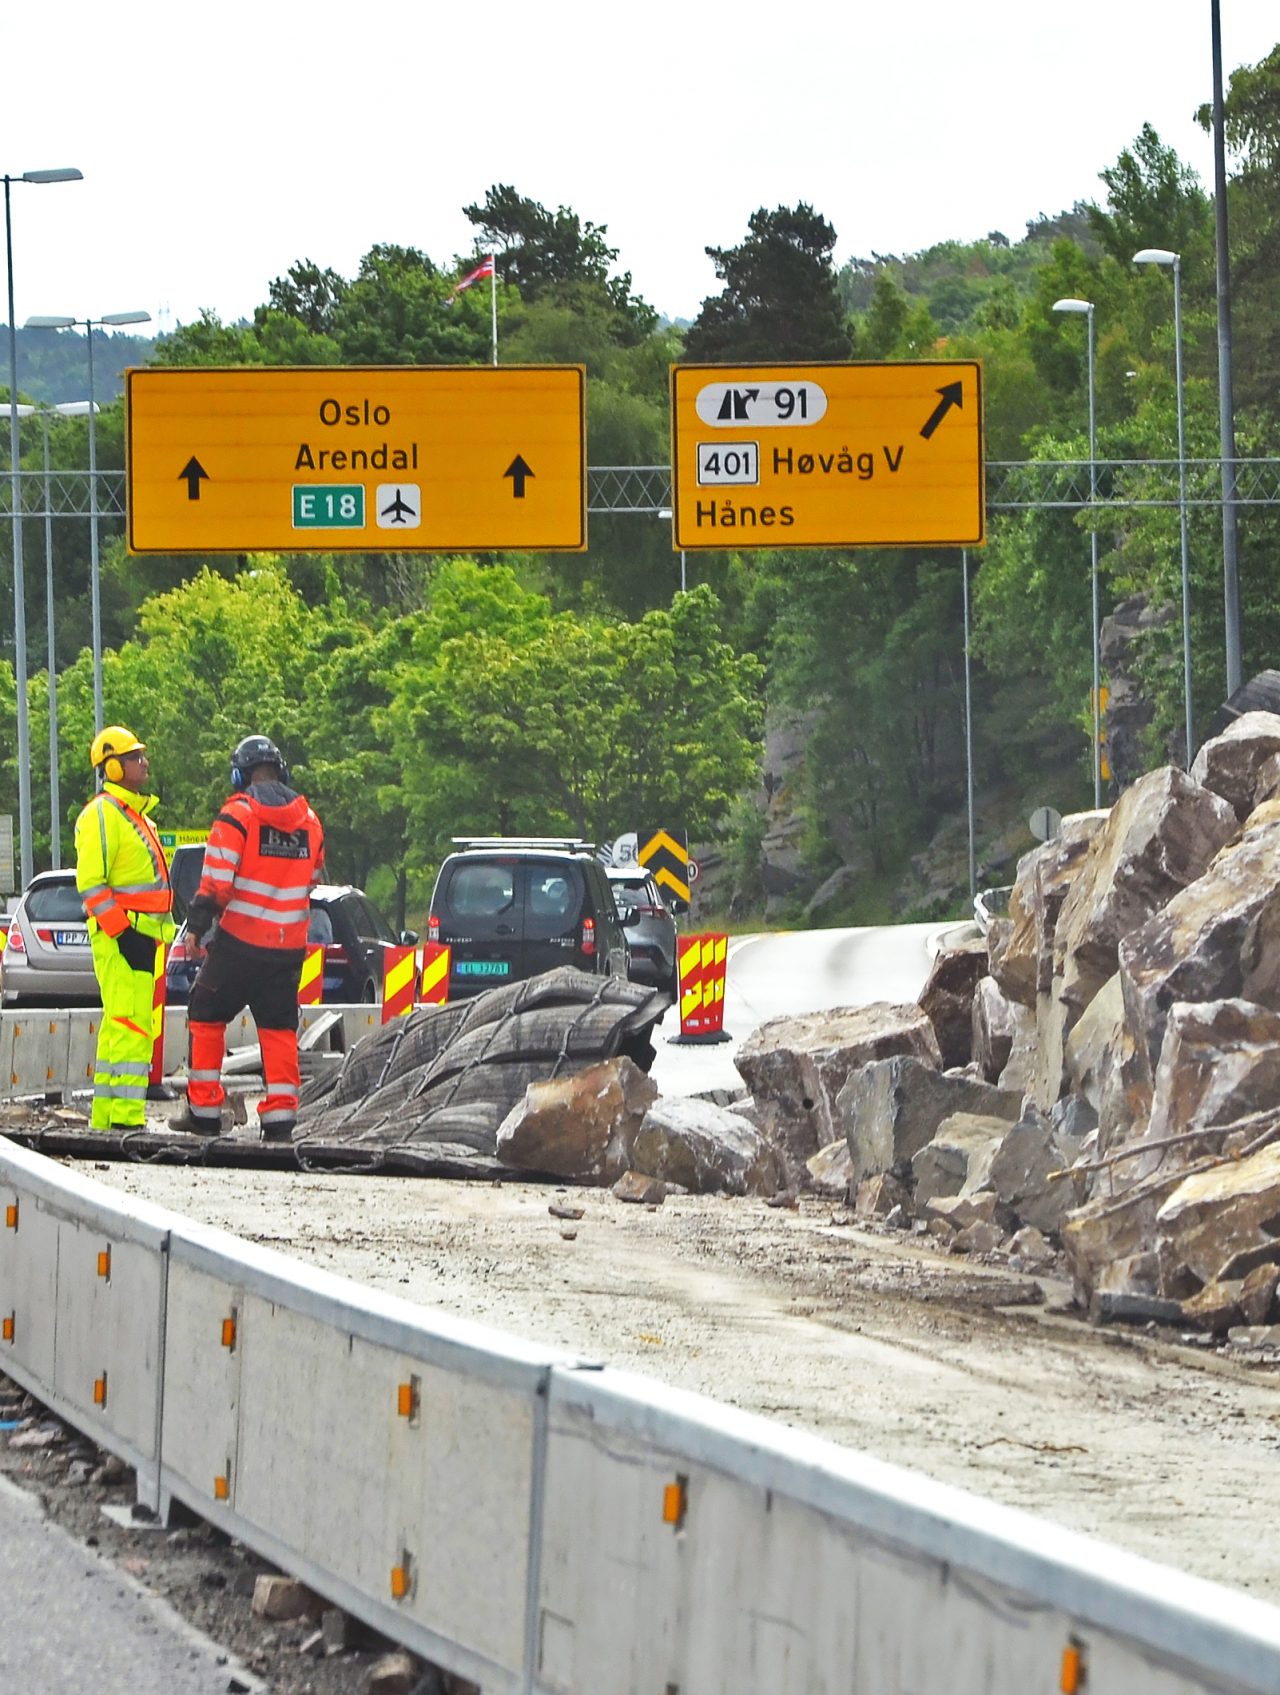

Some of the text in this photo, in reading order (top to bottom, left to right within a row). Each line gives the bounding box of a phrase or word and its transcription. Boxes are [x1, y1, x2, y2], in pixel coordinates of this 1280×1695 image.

[319, 398, 391, 427] Oslo
[774, 387, 808, 420] 91
[294, 442, 419, 471] Arendal
[704, 451, 751, 476] 401
[773, 445, 904, 481] Høvåg V
[696, 499, 796, 528] Hånes
